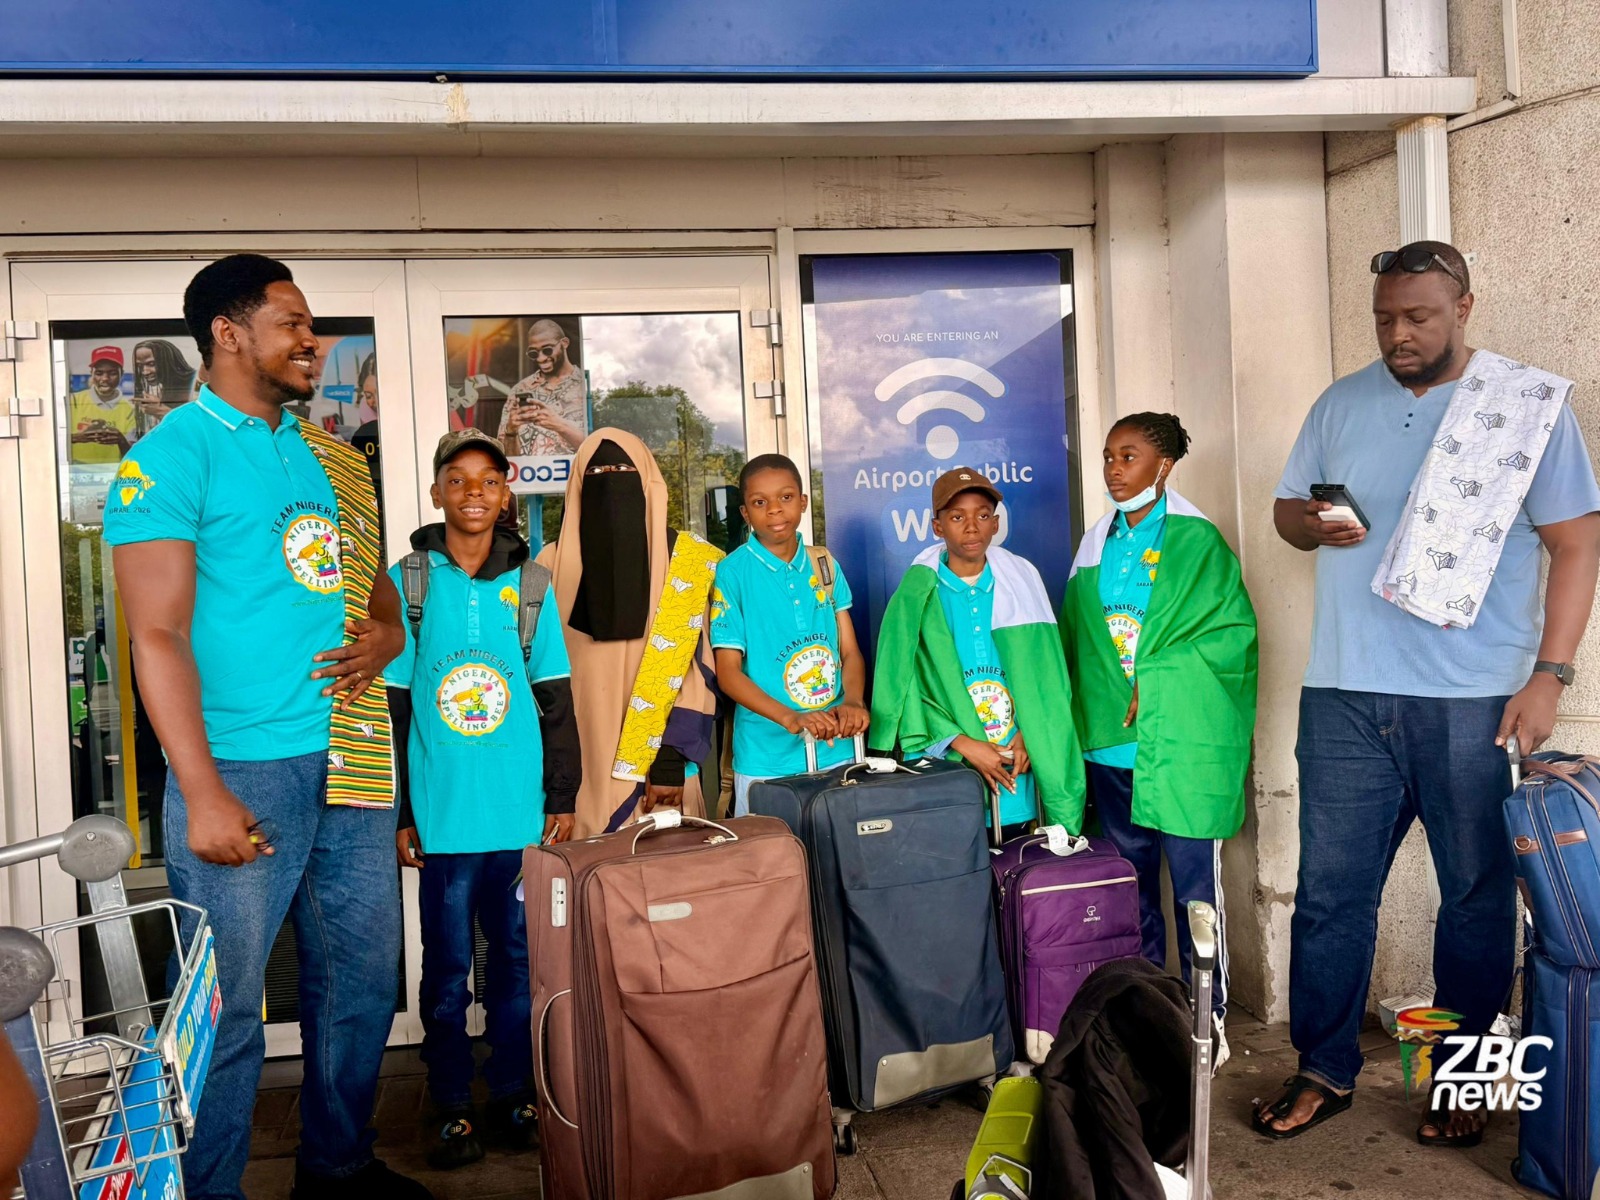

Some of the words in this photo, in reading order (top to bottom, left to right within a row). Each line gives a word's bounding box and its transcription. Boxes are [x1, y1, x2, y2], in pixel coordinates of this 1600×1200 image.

[876, 333, 900, 343] YOU
[903, 332, 924, 342] ARE
[927, 331, 981, 342] ENTERING
[983, 330, 999, 340] AN
[953, 461, 1033, 484] blic
[270, 503, 295, 535] TEAM
[288, 520, 335, 542] NIGERIA
[289, 557, 340, 588] SPELLING
[1114, 603, 1145, 618] NIGER
[776, 640, 802, 663] TEAM
[791, 649, 830, 669] NIGERIA
[432, 649, 465, 673] TEAM
[469, 648, 514, 679] NIGERIA
[977, 666, 1006, 679] NIGER
[448, 669, 500, 687] NIGERIA
[789, 681, 831, 704] SPELLING
[972, 685, 1004, 697] GERIA
[442, 699, 487, 731] SPELLING
[490, 700, 504, 722] BEE
